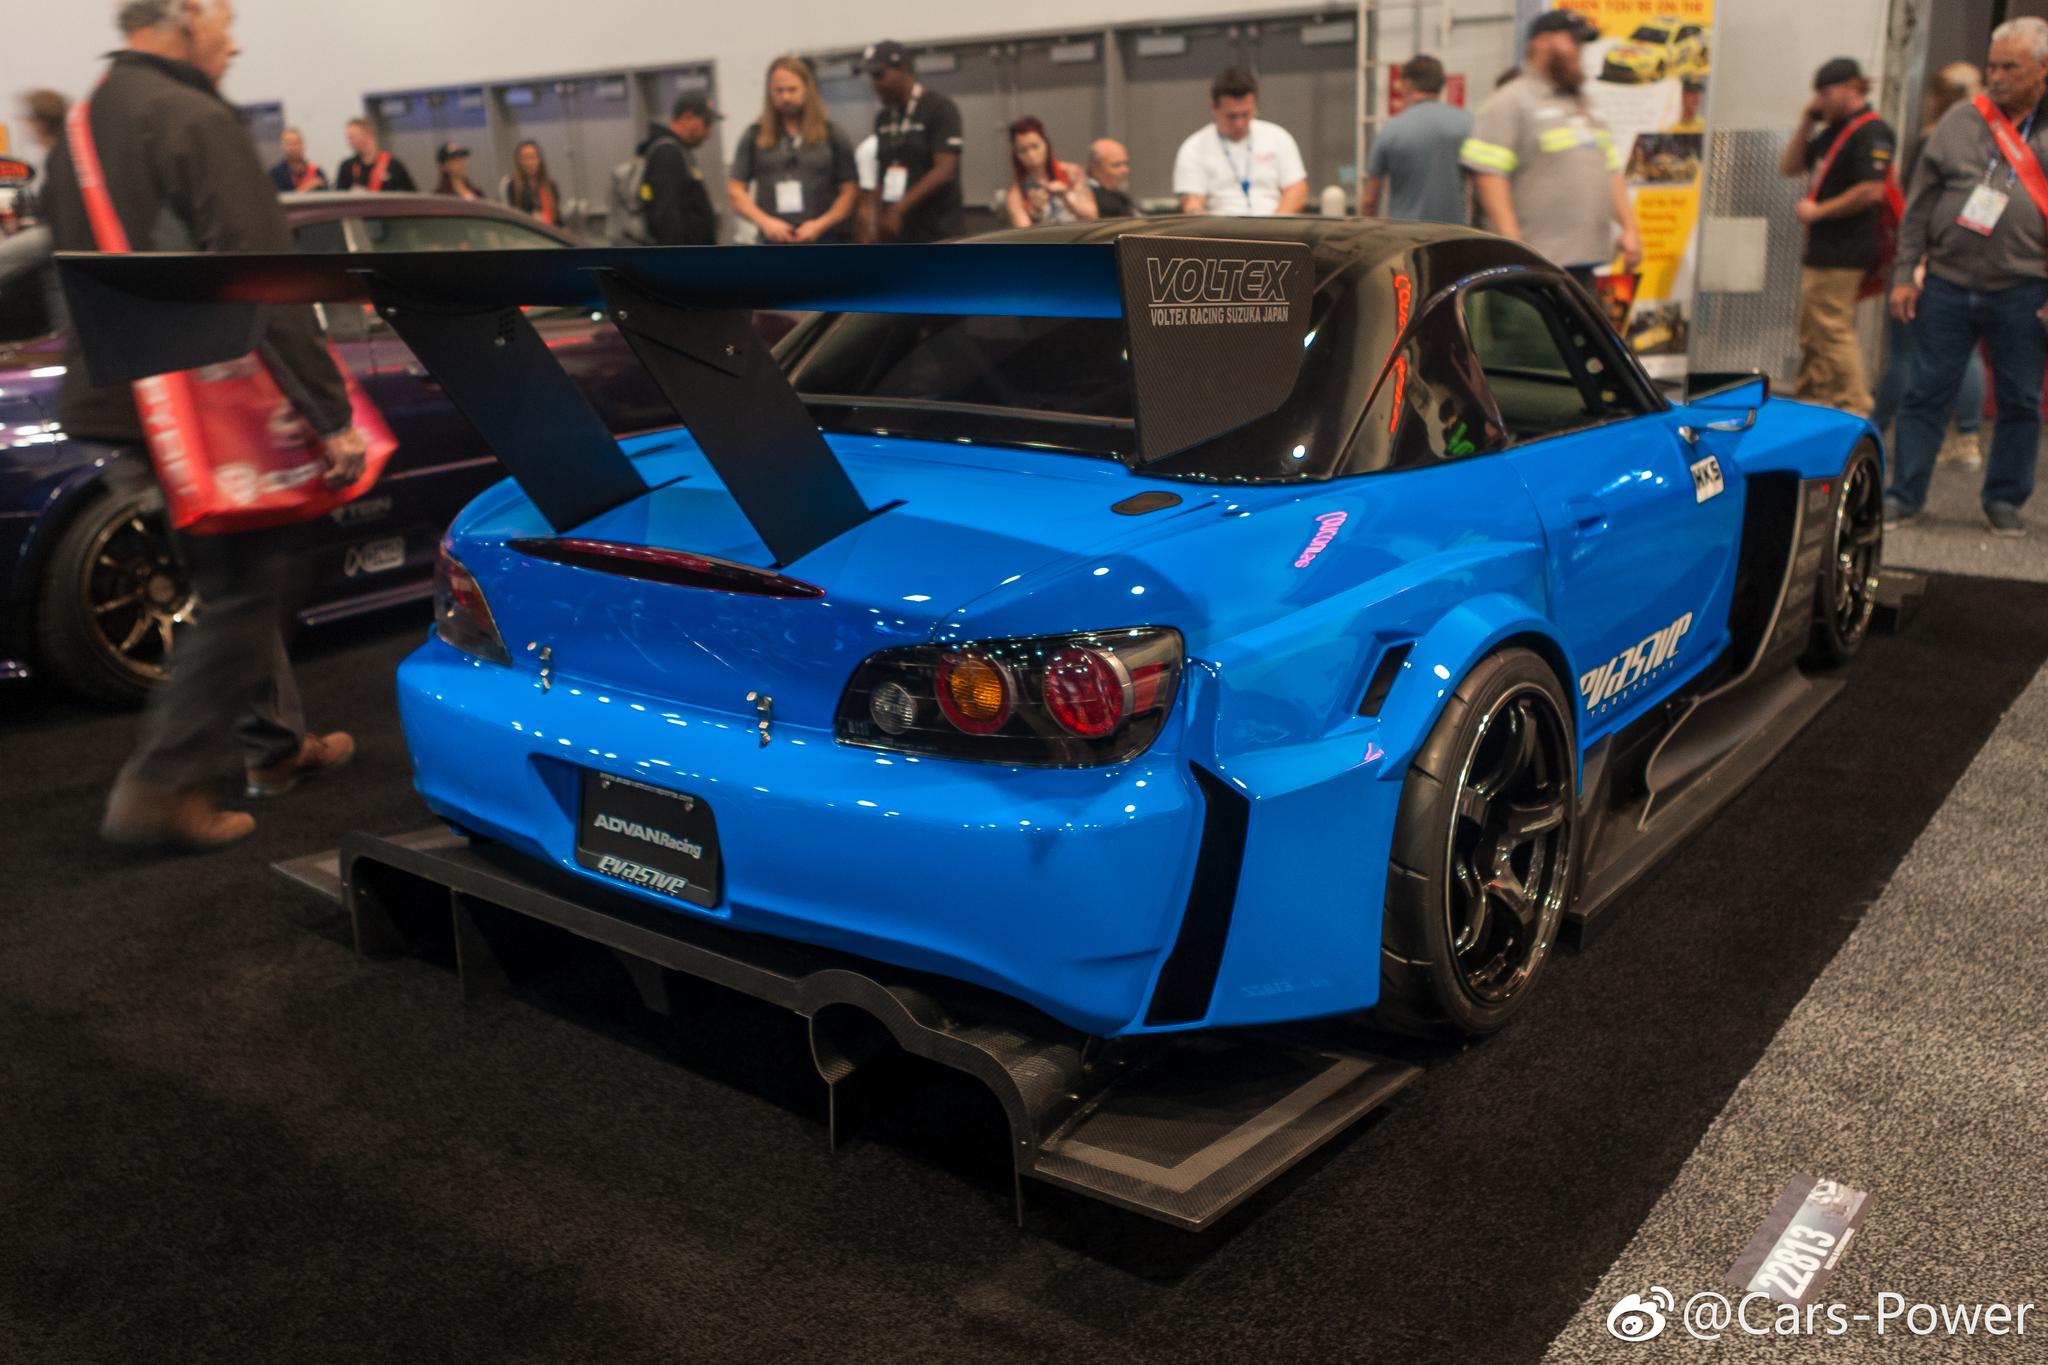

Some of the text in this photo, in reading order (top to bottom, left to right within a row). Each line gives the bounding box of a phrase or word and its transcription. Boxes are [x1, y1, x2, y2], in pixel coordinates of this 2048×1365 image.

[1146, 257, 1292, 303] VOLTEX
[1150, 305, 1289, 326] VOLTEX RACING SUZUKA JAPAN
[1692, 460, 1722, 491] HKS
[1757, 1224, 1836, 1300] 22813
